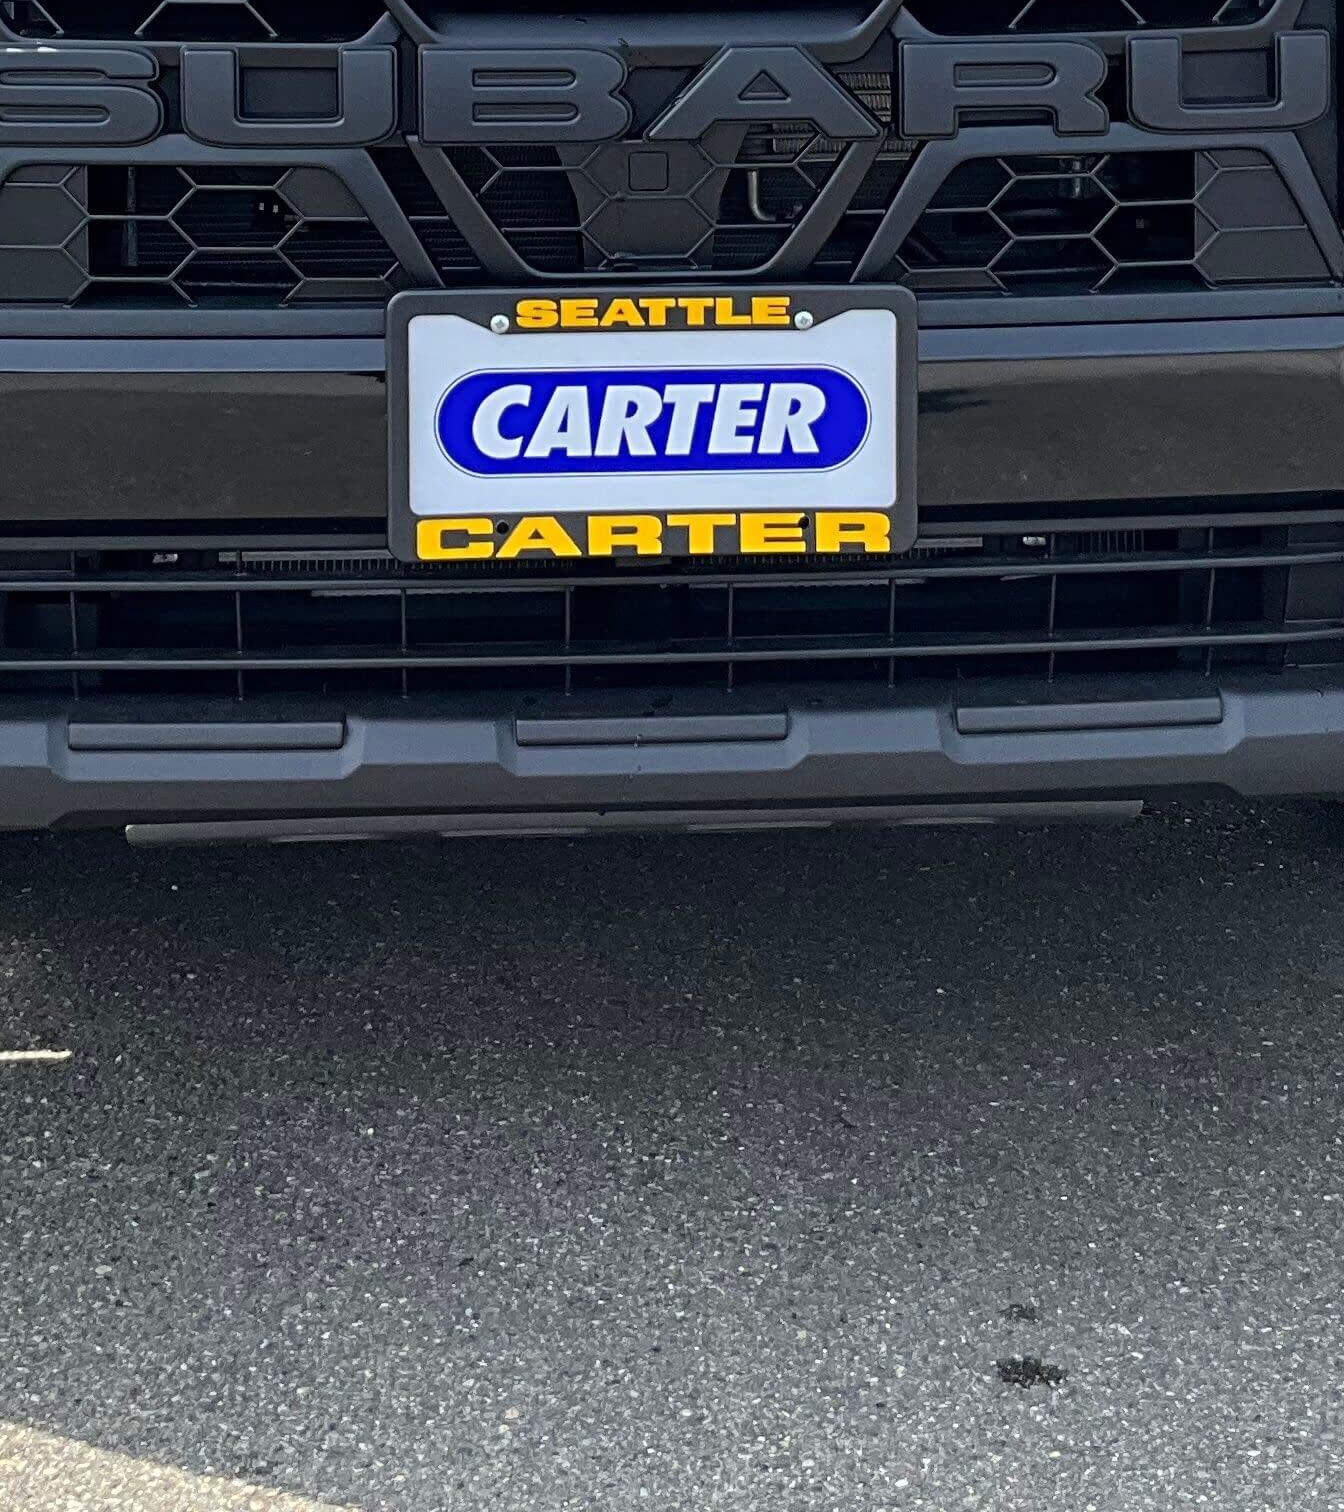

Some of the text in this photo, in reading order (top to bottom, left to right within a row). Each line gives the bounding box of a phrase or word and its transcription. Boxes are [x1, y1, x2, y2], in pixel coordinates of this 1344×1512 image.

[514, 295, 791, 329] SEATTLE
[471, 382, 826, 460] CARTER
[416, 511, 892, 561] CARTER
